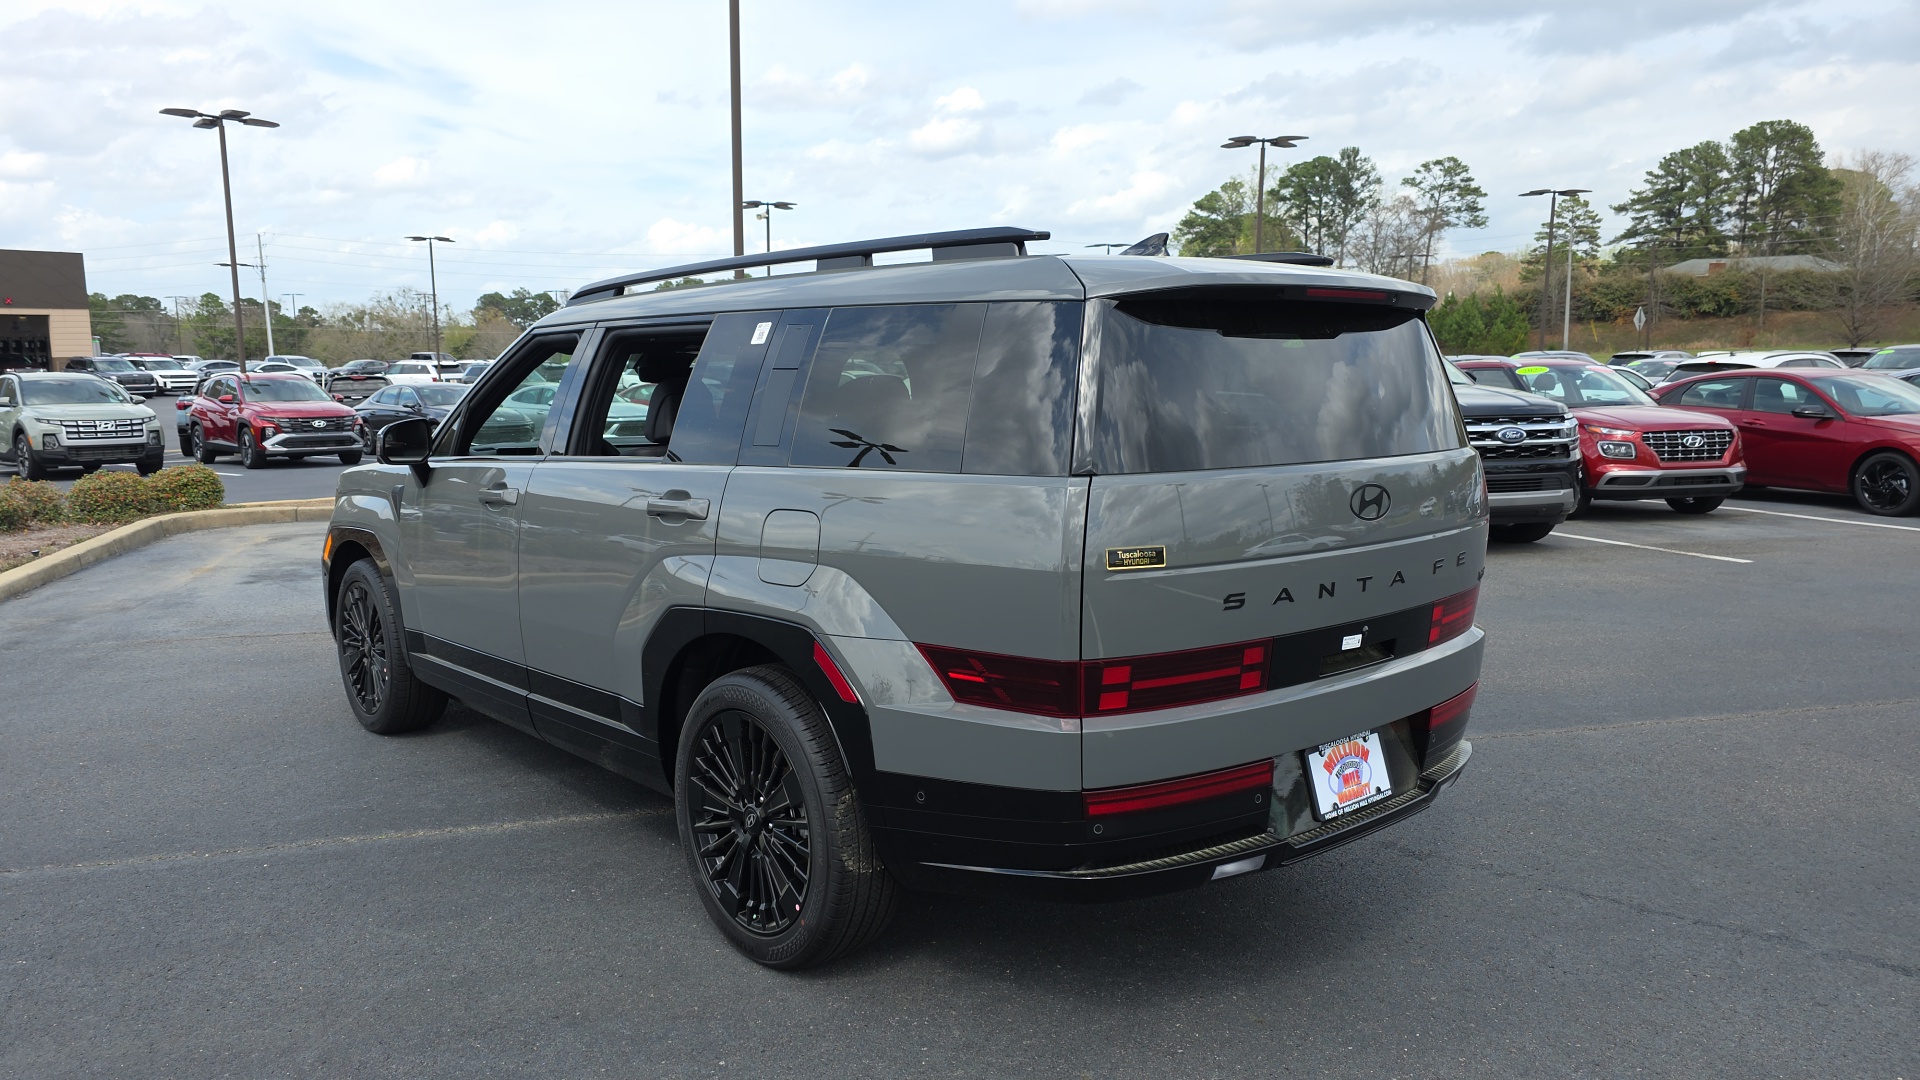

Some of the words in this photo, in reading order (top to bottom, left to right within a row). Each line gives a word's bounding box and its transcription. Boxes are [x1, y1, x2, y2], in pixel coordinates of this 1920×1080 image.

[1506, 431, 1521, 439] Ford
[1117, 549, 1156, 559] Tuscaloosa
[1123, 558, 1150, 566] HYUNDAI
[1222, 570, 1406, 611] SANTA
[1432, 551, 1468, 575] FE
[1318, 736, 1350, 751] TUSCALOOSA
[1350, 730, 1371, 741] HYUNDAI
[1323, 740, 1370, 776] MILLION
[1342, 769, 1361, 789] MILE
[1336, 781, 1371, 805] WARRANTY
[1324, 810, 1338, 820] HOME
[1338, 807, 1344, 816] OF
[1343, 802, 1360, 813] MILLION
